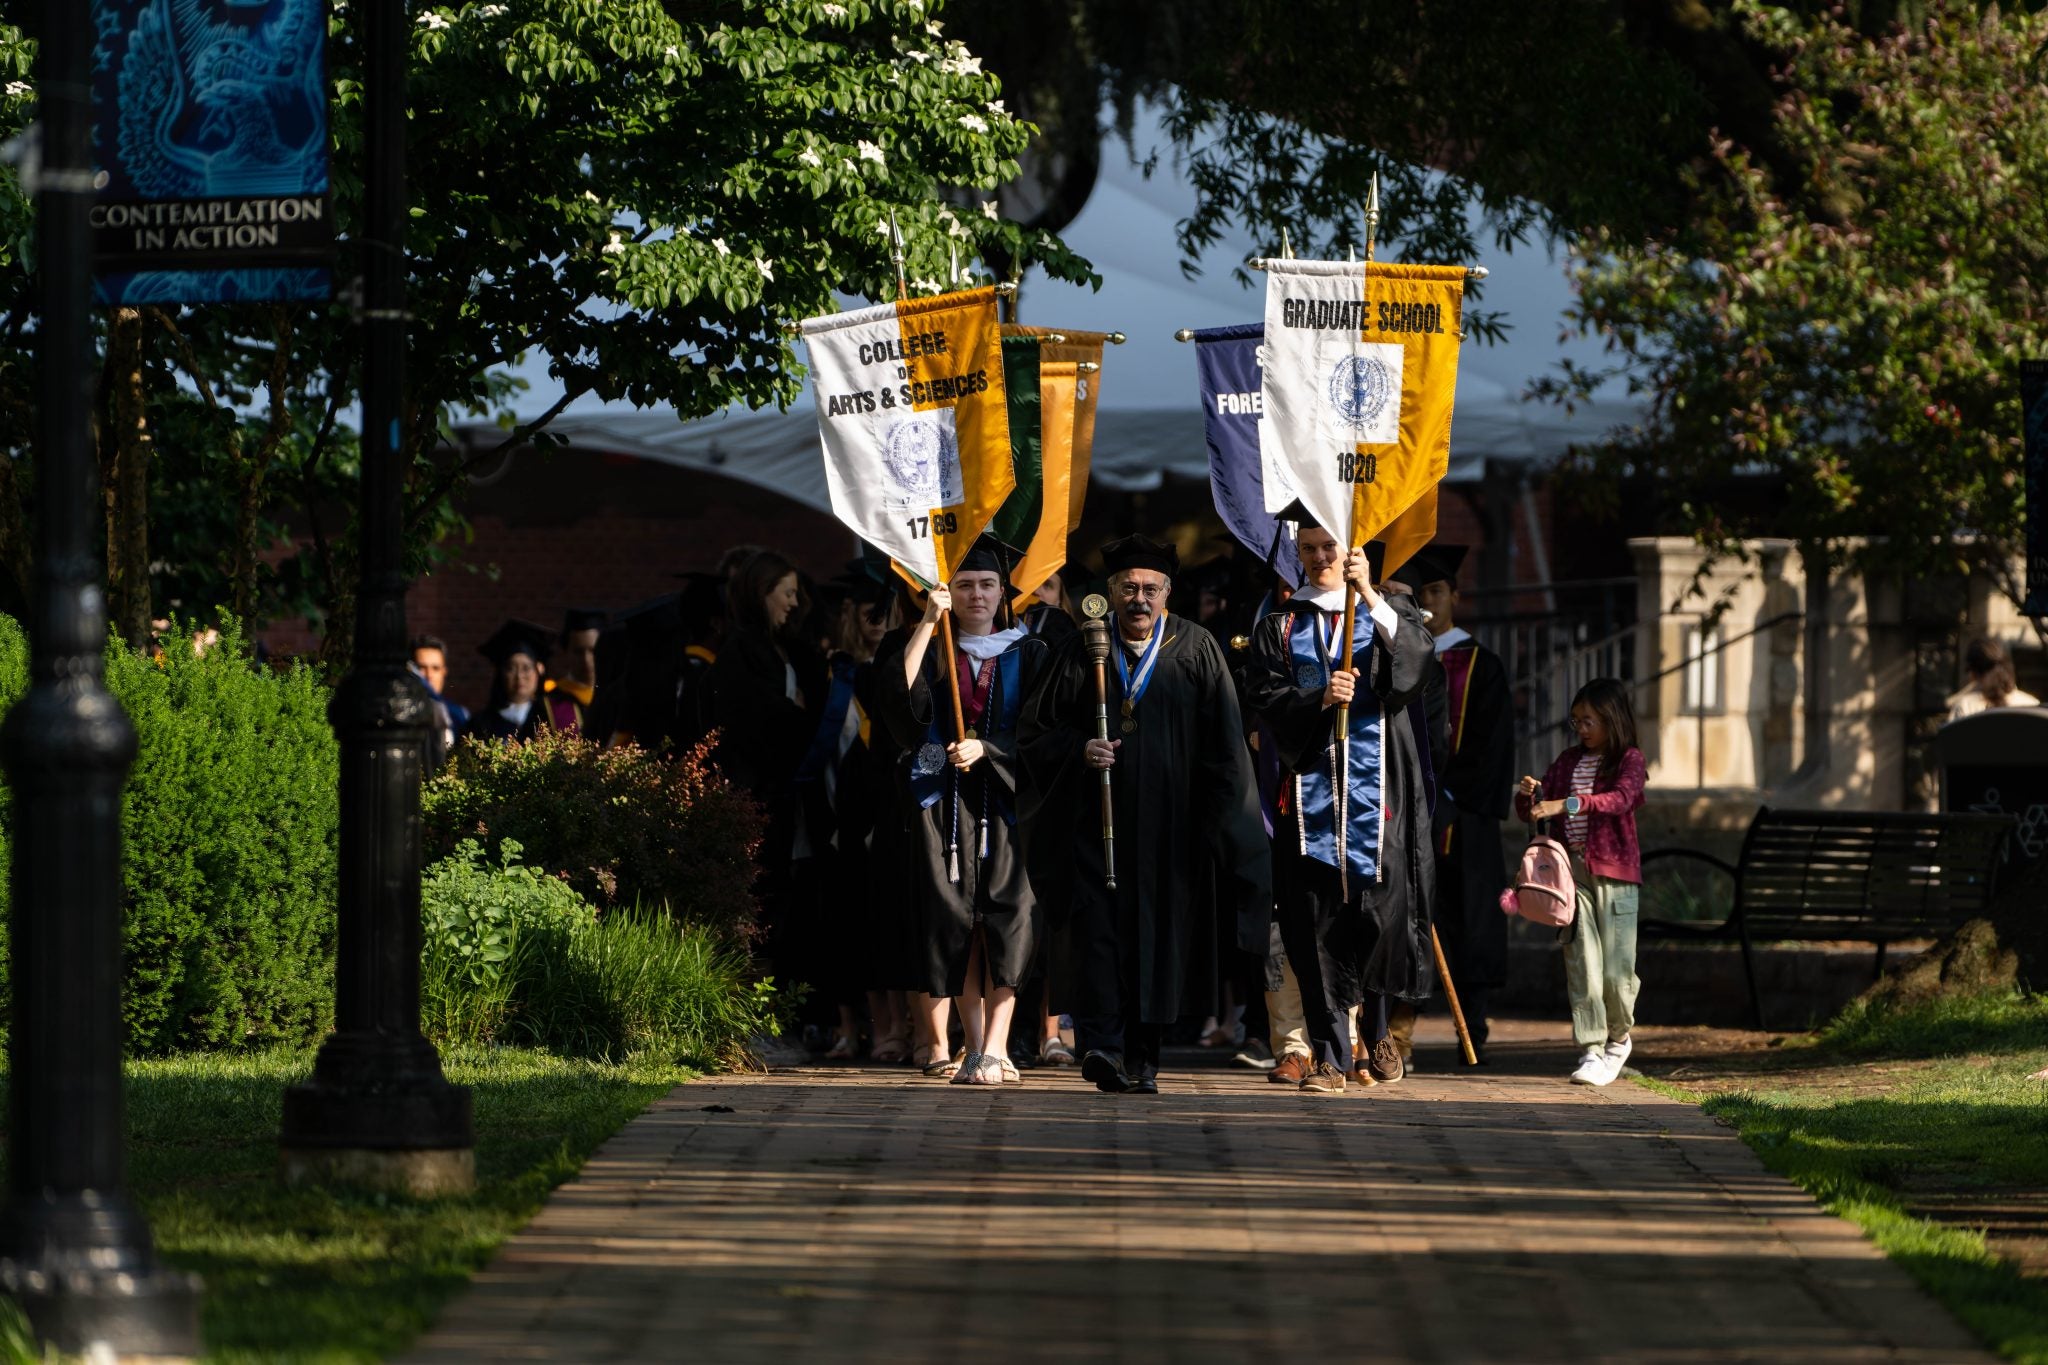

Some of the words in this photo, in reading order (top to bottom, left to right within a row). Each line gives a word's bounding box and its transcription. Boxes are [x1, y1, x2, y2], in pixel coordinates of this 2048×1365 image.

[89, 198, 322, 228] CONTEMPLATION
[135, 229, 165, 249] IN
[173, 224, 279, 249] ACTION
[1283, 298, 1370, 331] GRADUATE
[1378, 301, 1445, 334] SCHOOL
[859, 331, 946, 366] COLLEGE
[897, 365, 915, 381] OF
[828, 388, 876, 417] ARTS
[881, 387, 897, 409] &
[901, 370, 989, 405] SCIENCES
[1077, 378, 1088, 401] S
[1337, 453, 1377, 484] 1820
[906, 513, 958, 540] 1789
